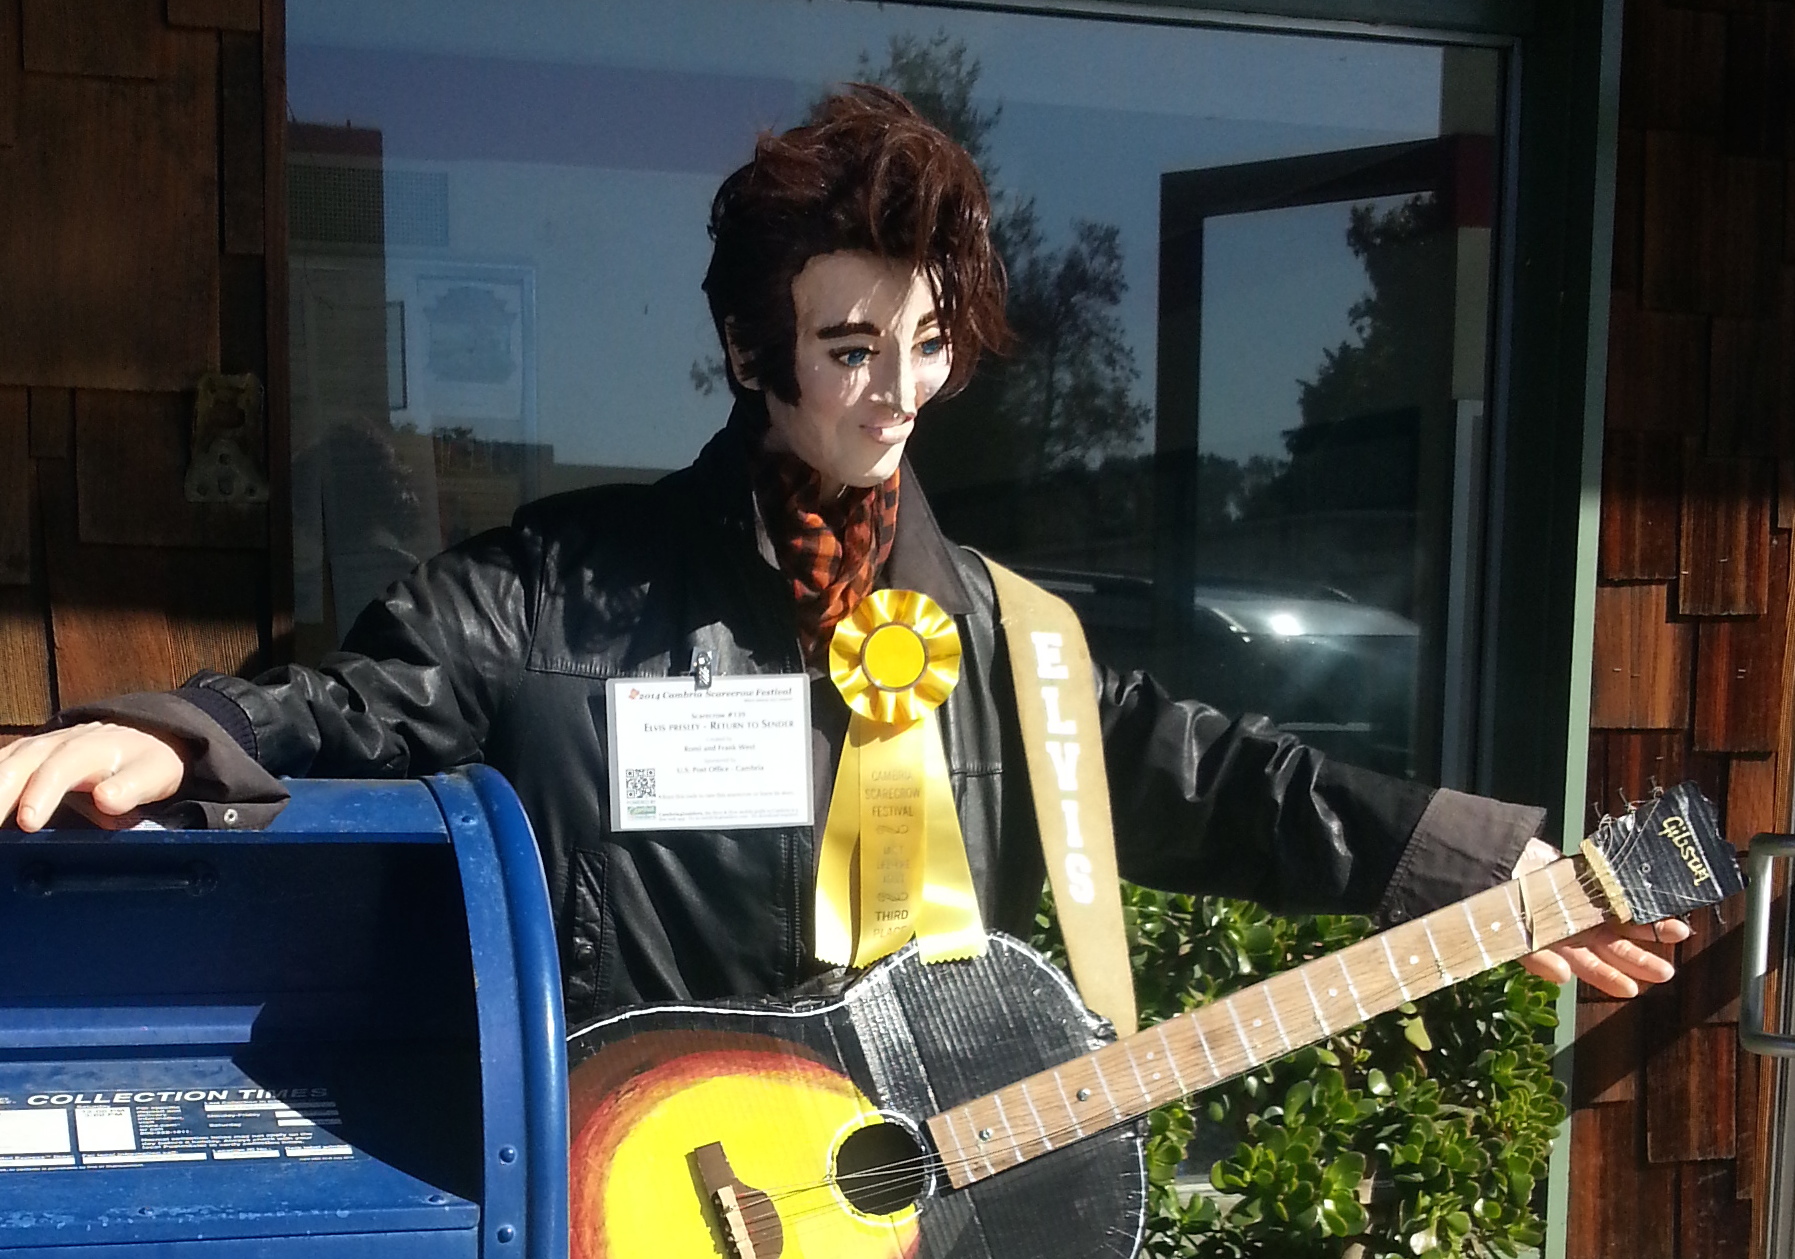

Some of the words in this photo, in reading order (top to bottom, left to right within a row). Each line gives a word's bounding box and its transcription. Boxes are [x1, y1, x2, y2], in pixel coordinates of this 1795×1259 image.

[662, 690, 703, 699] Cambria
[705, 689, 754, 698] Scarecrow
[756, 687, 792, 697] Festival
[710, 721, 744, 730] RETURN
[747, 721, 759, 729] TO
[761, 719, 794, 729] SENDER
[709, 765, 729, 773] Office
[735, 764, 764, 772] Cambria
[1029, 630, 1096, 905] ELVIS
[871, 769, 912, 781] CAMBRIA
[864, 786, 921, 800] SCARECROW
[871, 805, 914, 817] FESTIVAL
[1657, 815, 1711, 887] Gibson
[875, 909, 909, 921] THIRD
[27, 1090, 229, 1105] COLLECTION
[238, 1088, 328, 1099] TIMES
